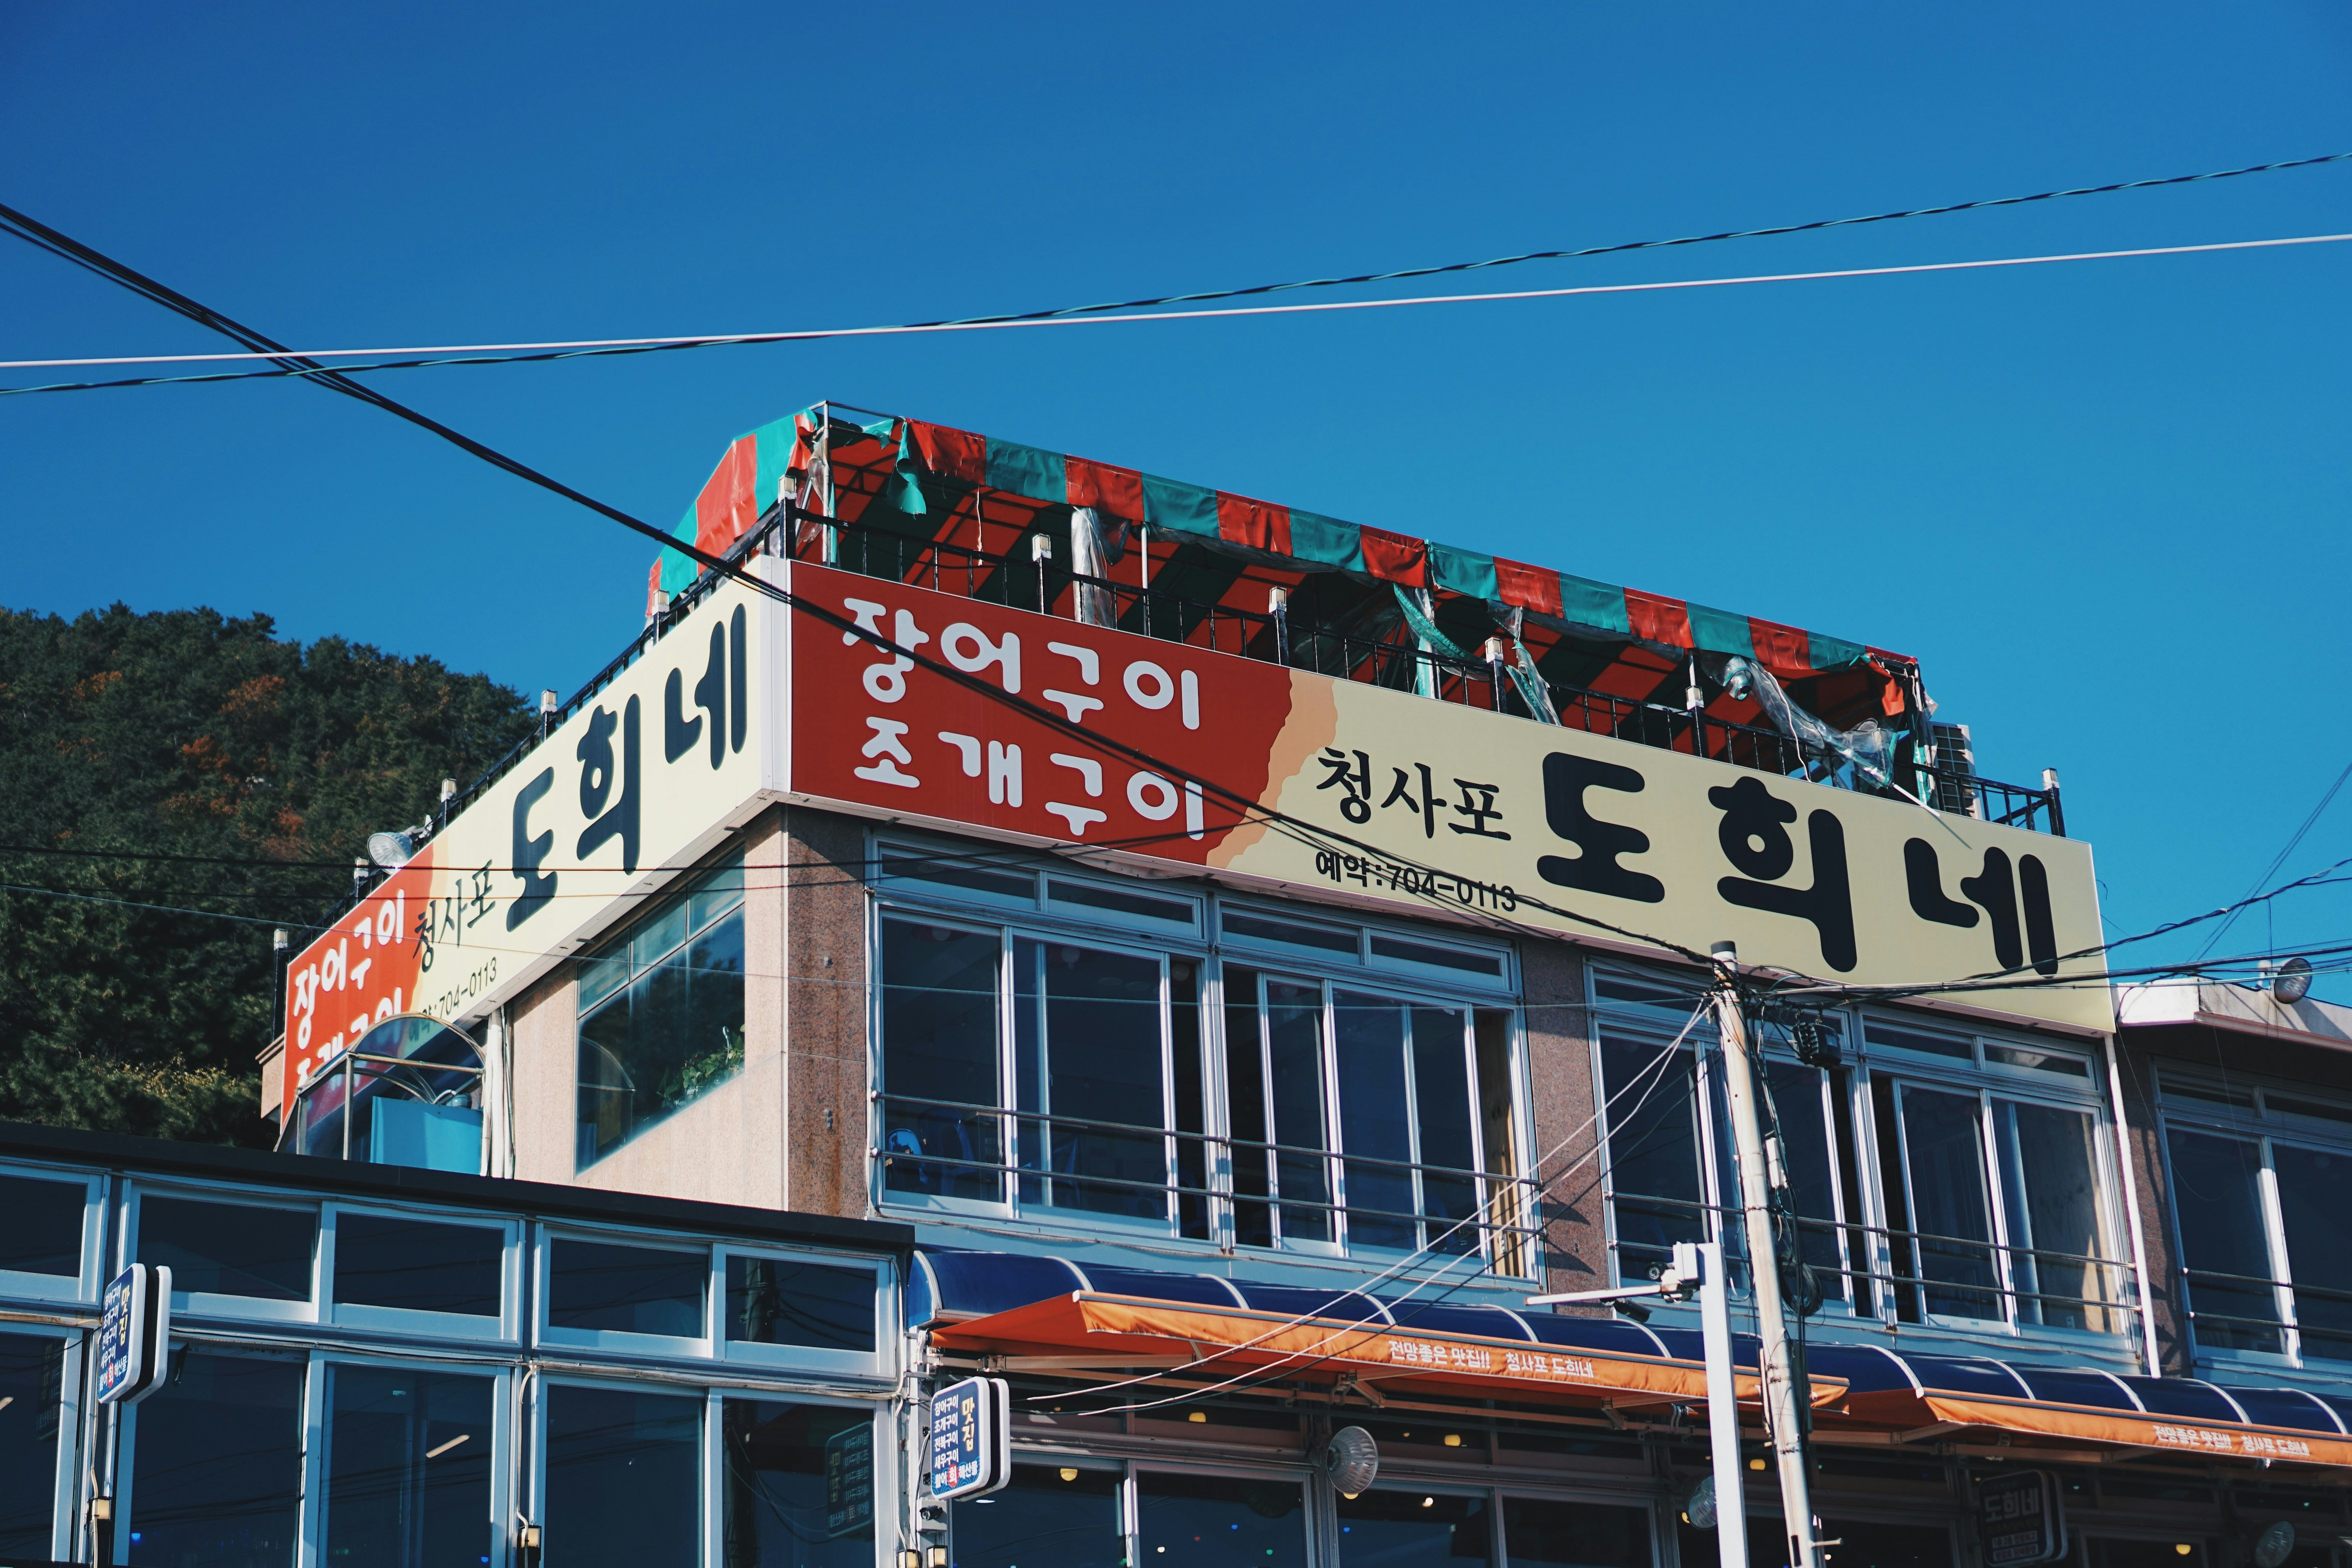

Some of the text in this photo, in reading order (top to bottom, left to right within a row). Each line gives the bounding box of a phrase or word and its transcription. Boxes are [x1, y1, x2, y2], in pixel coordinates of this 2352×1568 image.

[843, 597, 1199, 730] 장어구이
[506, 603, 746, 933] 도희네
[853, 716, 1204, 841] 조개구이
[1316, 746, 1511, 841] 청사포
[1536, 751, 2059, 976] 도희네
[413, 857, 496, 972] 청사포
[293, 888, 405, 1050] 장어구이
[105, 1282, 121, 1310] 장어구이
[119, 1284, 130, 1346] 맛집
[1389, 1340, 1449, 1365] 전망좋은
[1505, 1352, 1549, 1373] 청사포
[1552, 1358, 1594, 1379] 도희네
[934, 1412, 958, 1433] 조개구이
[935, 1394, 959, 1416] 장어구이
[962, 1396, 975, 1452] 맛집
[935, 1430, 959, 1452] 전복구이
[935, 1448, 959, 1469] 새우구이
[948, 1465, 958, 1484] 회
[959, 1460, 978, 1479] 해산물
[1984, 1487, 2040, 1522] 도희네
